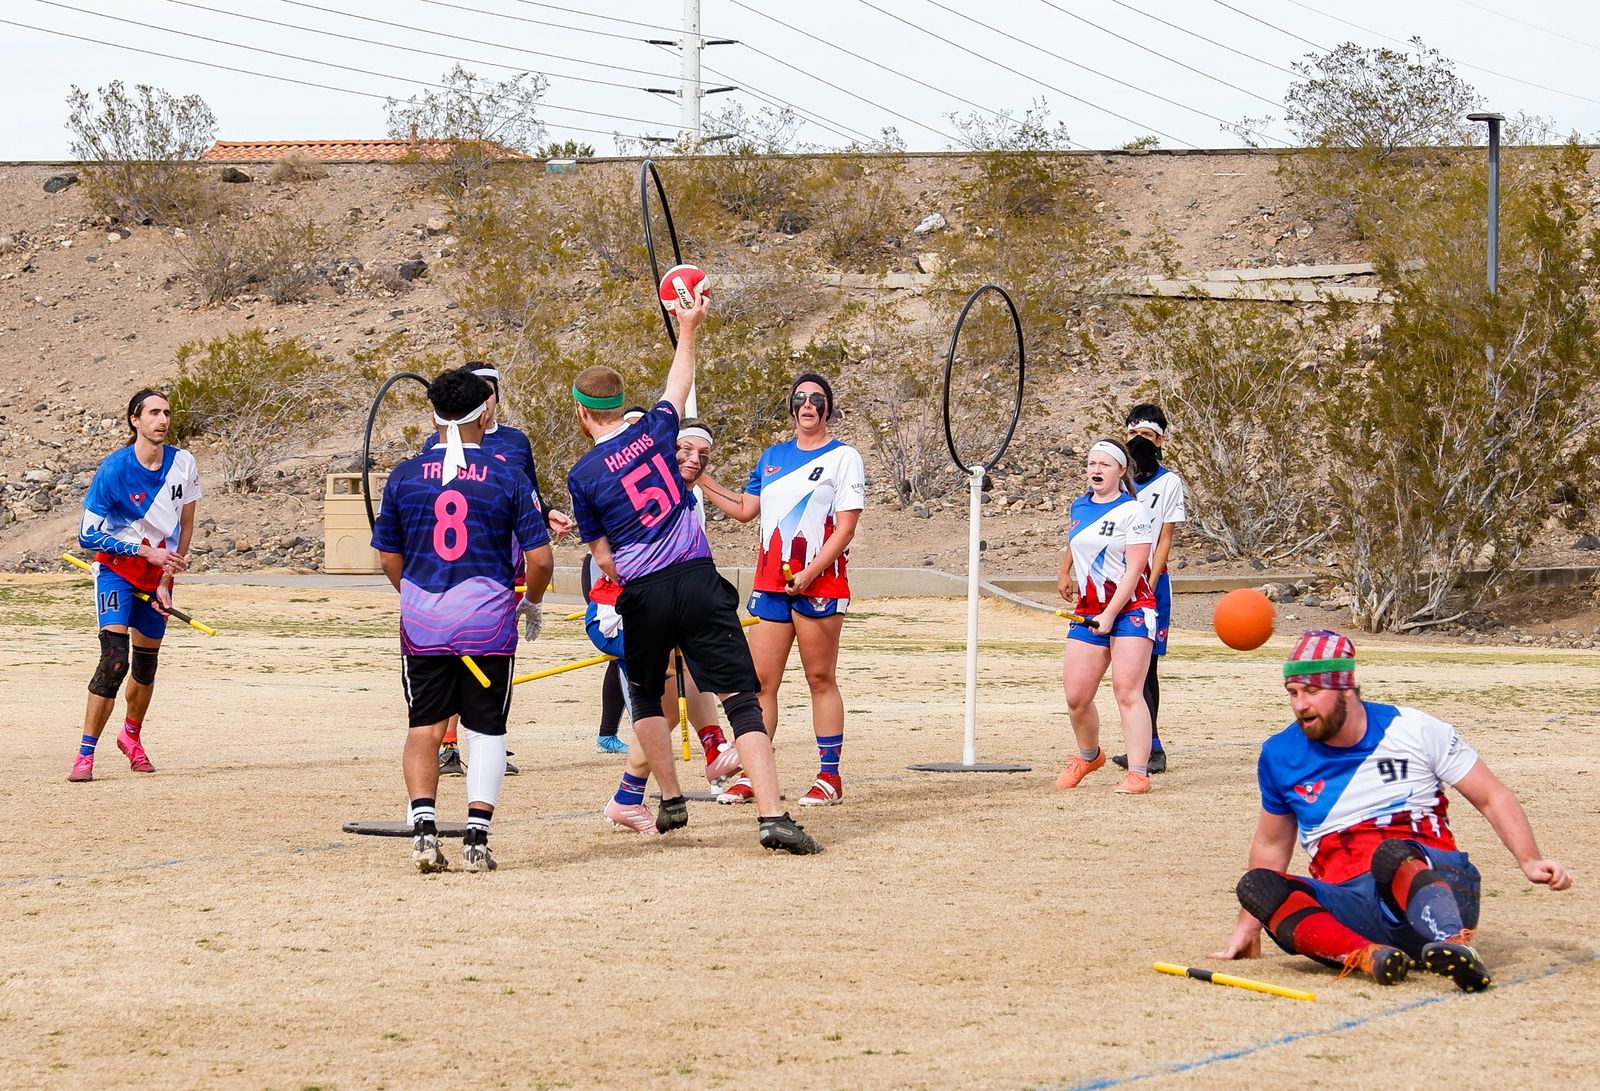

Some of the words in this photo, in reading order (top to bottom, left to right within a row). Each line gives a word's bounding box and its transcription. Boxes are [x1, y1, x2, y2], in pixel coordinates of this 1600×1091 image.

[604, 433, 654, 473] HARRIS
[422, 462, 488, 481] TRGAJ
[808, 467, 824, 481] 8
[171, 484, 182, 500] 14
[620, 453, 681, 528] 51
[1150, 492, 1160, 509] 7
[433, 489, 468, 562] 8
[1099, 520, 1116, 537] 33
[100, 589, 120, 615] 14
[1376, 758, 1409, 784] 97
